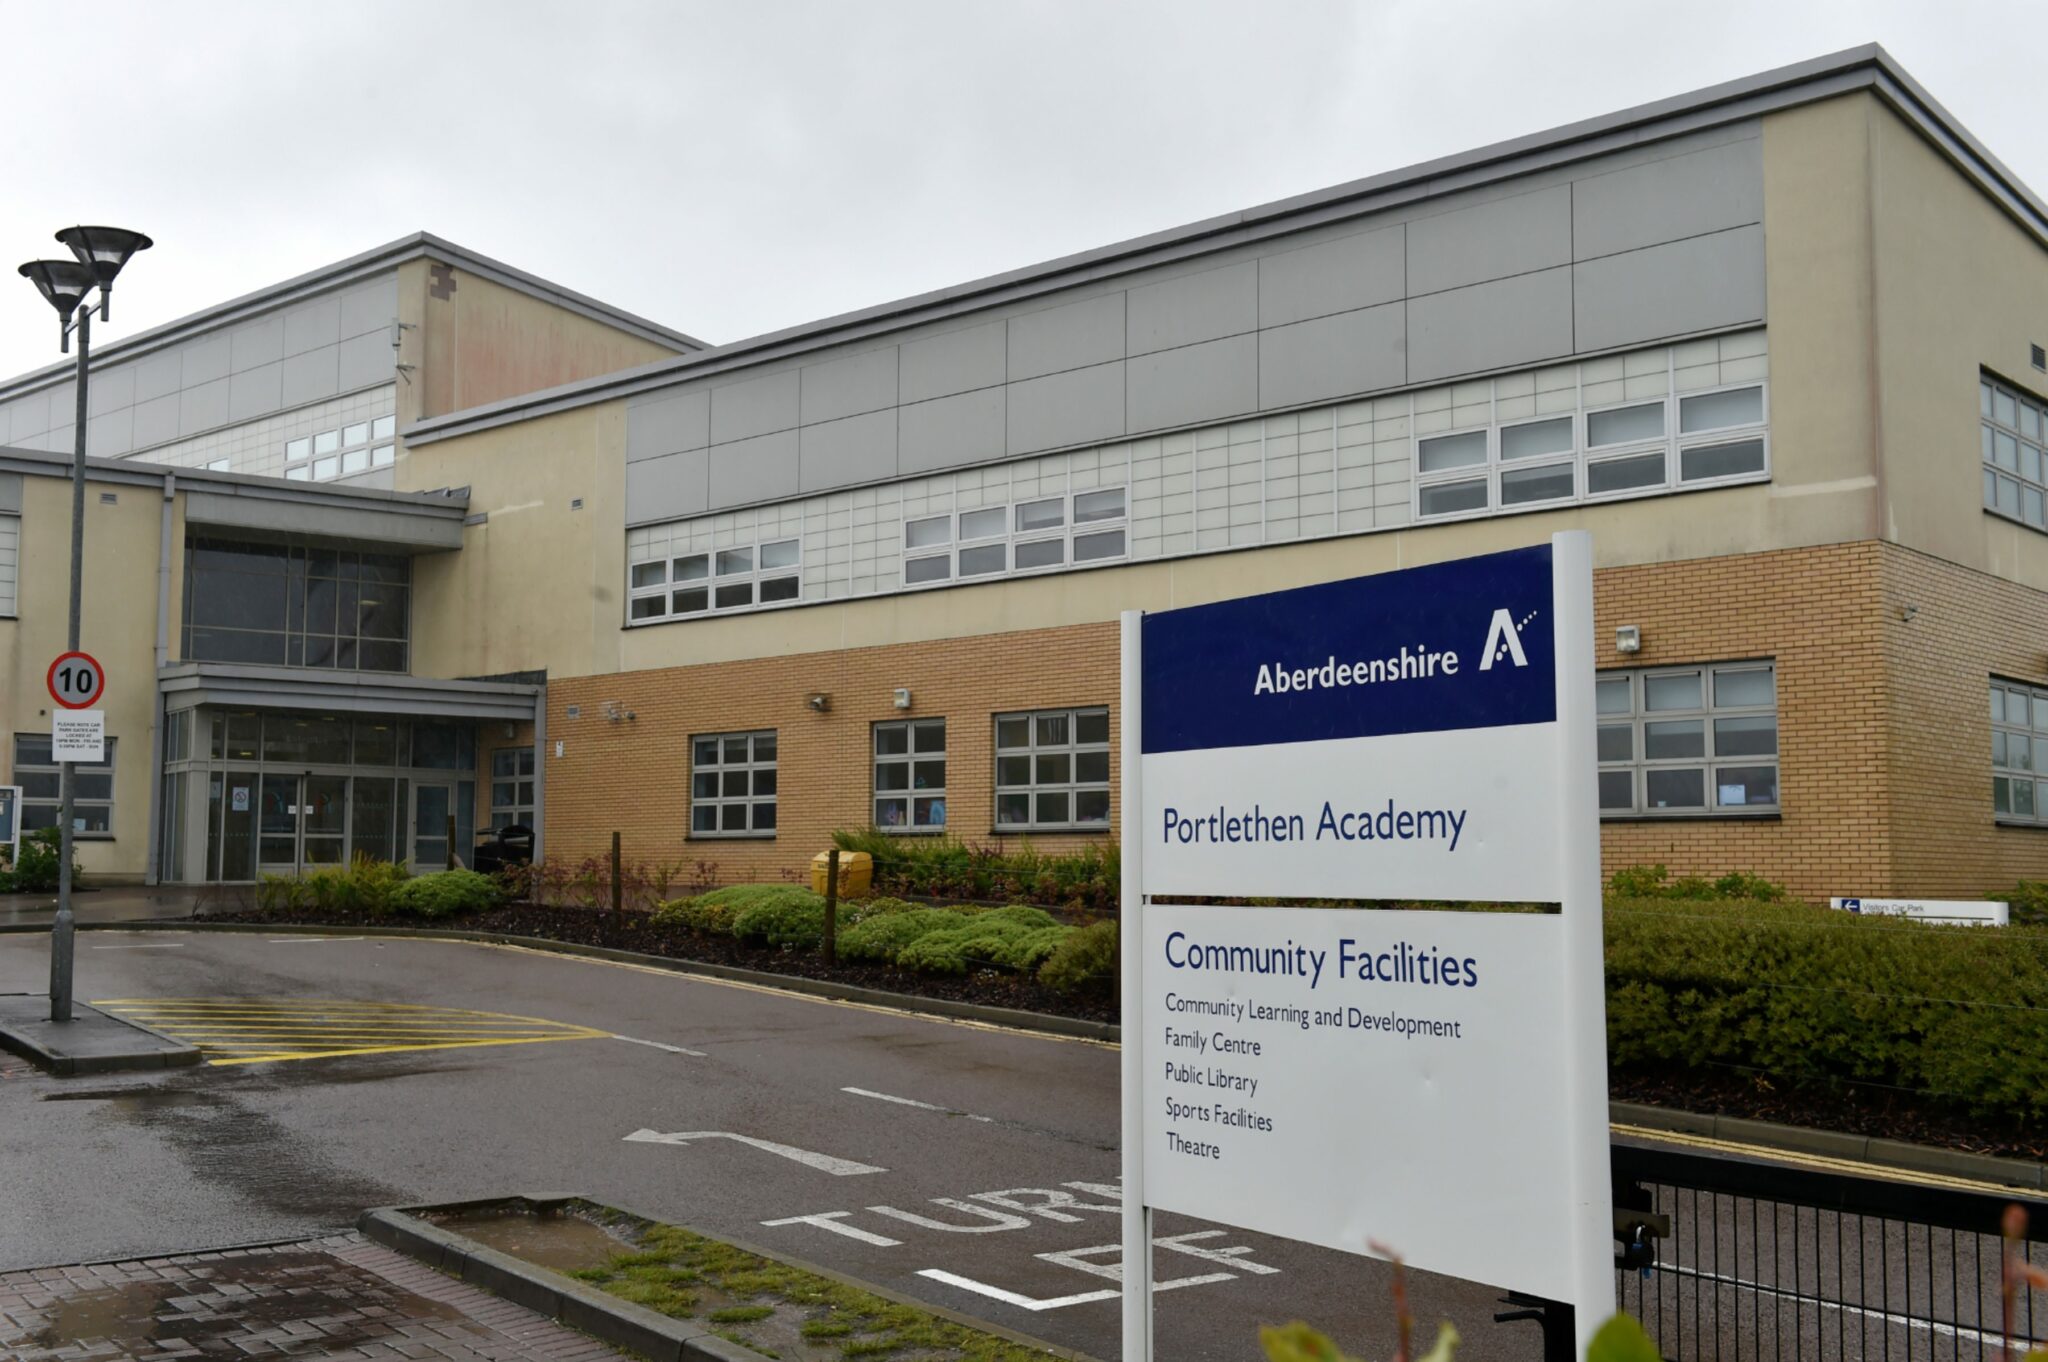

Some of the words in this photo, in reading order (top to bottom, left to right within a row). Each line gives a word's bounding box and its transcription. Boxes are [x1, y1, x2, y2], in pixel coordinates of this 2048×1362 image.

[59, 667, 93, 694] 10
[1253, 644, 1459, 696] Aberdeenshire
[1164, 804, 1304, 844] Portlethen
[1315, 799, 1467, 852] Academy
[1863, 903, 1889, 912] Visitors
[1891, 904, 1905, 912] Car
[1907, 904, 1924, 912] Park
[1165, 931, 1327, 989] Community
[1339, 938, 1478, 988] Facilities
[1165, 992, 1245, 1023] Community
[1249, 999, 1310, 1030] Learning
[1314, 1006, 1343, 1028] and
[1347, 1007, 1462, 1040] Development
[1165, 1027, 1208, 1055] Family
[1212, 1031, 1261, 1056] Centre
[1165, 1061, 1203, 1086] Public
[1207, 1067, 1258, 1098] Library
[1166, 1096, 1210, 1122] Sports
[1214, 1103, 1273, 1132] Facilities
[1166, 1131, 1220, 1160] Theatre
[914, 1229, 1282, 1312] LEF
